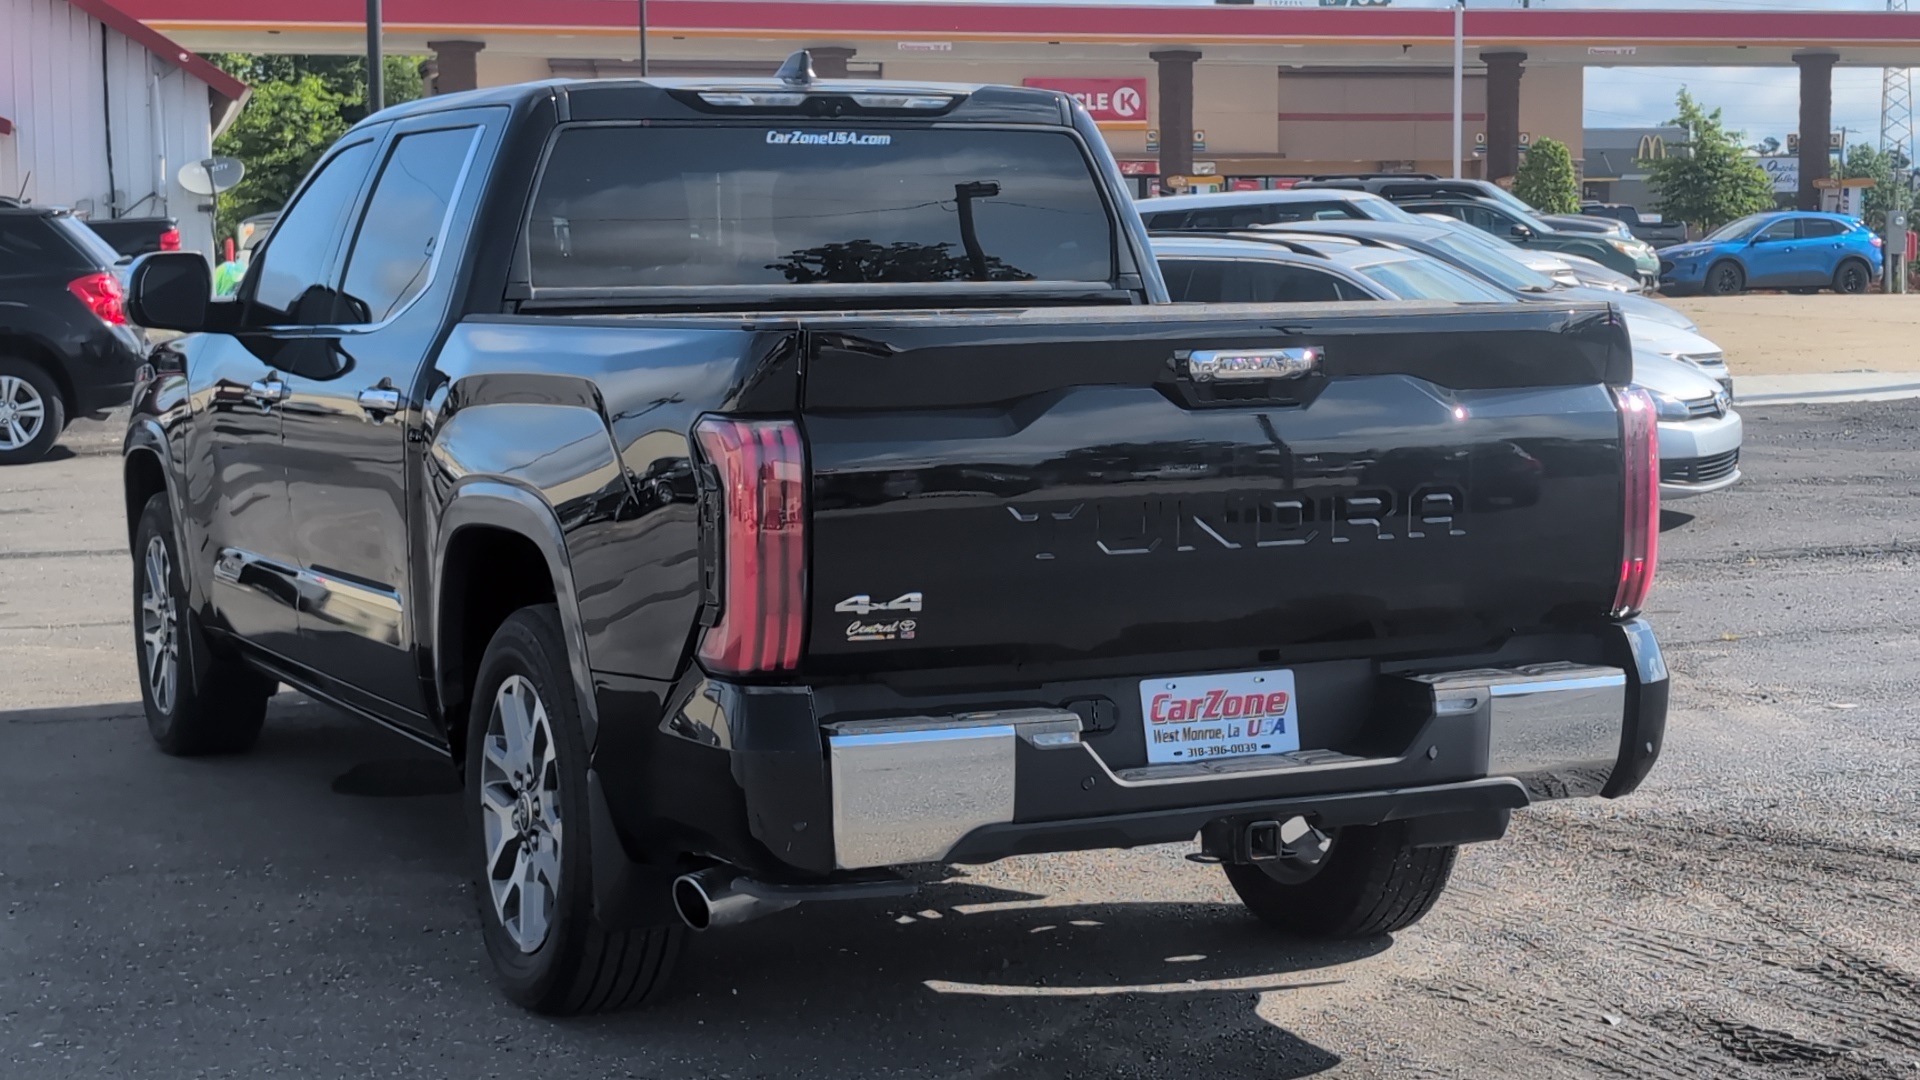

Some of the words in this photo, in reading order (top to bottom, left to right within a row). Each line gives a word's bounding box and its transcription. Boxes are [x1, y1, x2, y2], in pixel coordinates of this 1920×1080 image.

[1072, 92, 1109, 111] CLE
[765, 130, 892, 145] CarZoneUSA.com
[1006, 484, 1466, 560] TUNDRA
[1150, 689, 1290, 725] CarZone
[1153, 728, 1180, 744] West
[1182, 726, 1225, 742] Monroe,
[1228, 723, 1240, 738] La
[1247, 717, 1286, 737] USA
[1186, 742, 1258, 758] 318-396-0039
